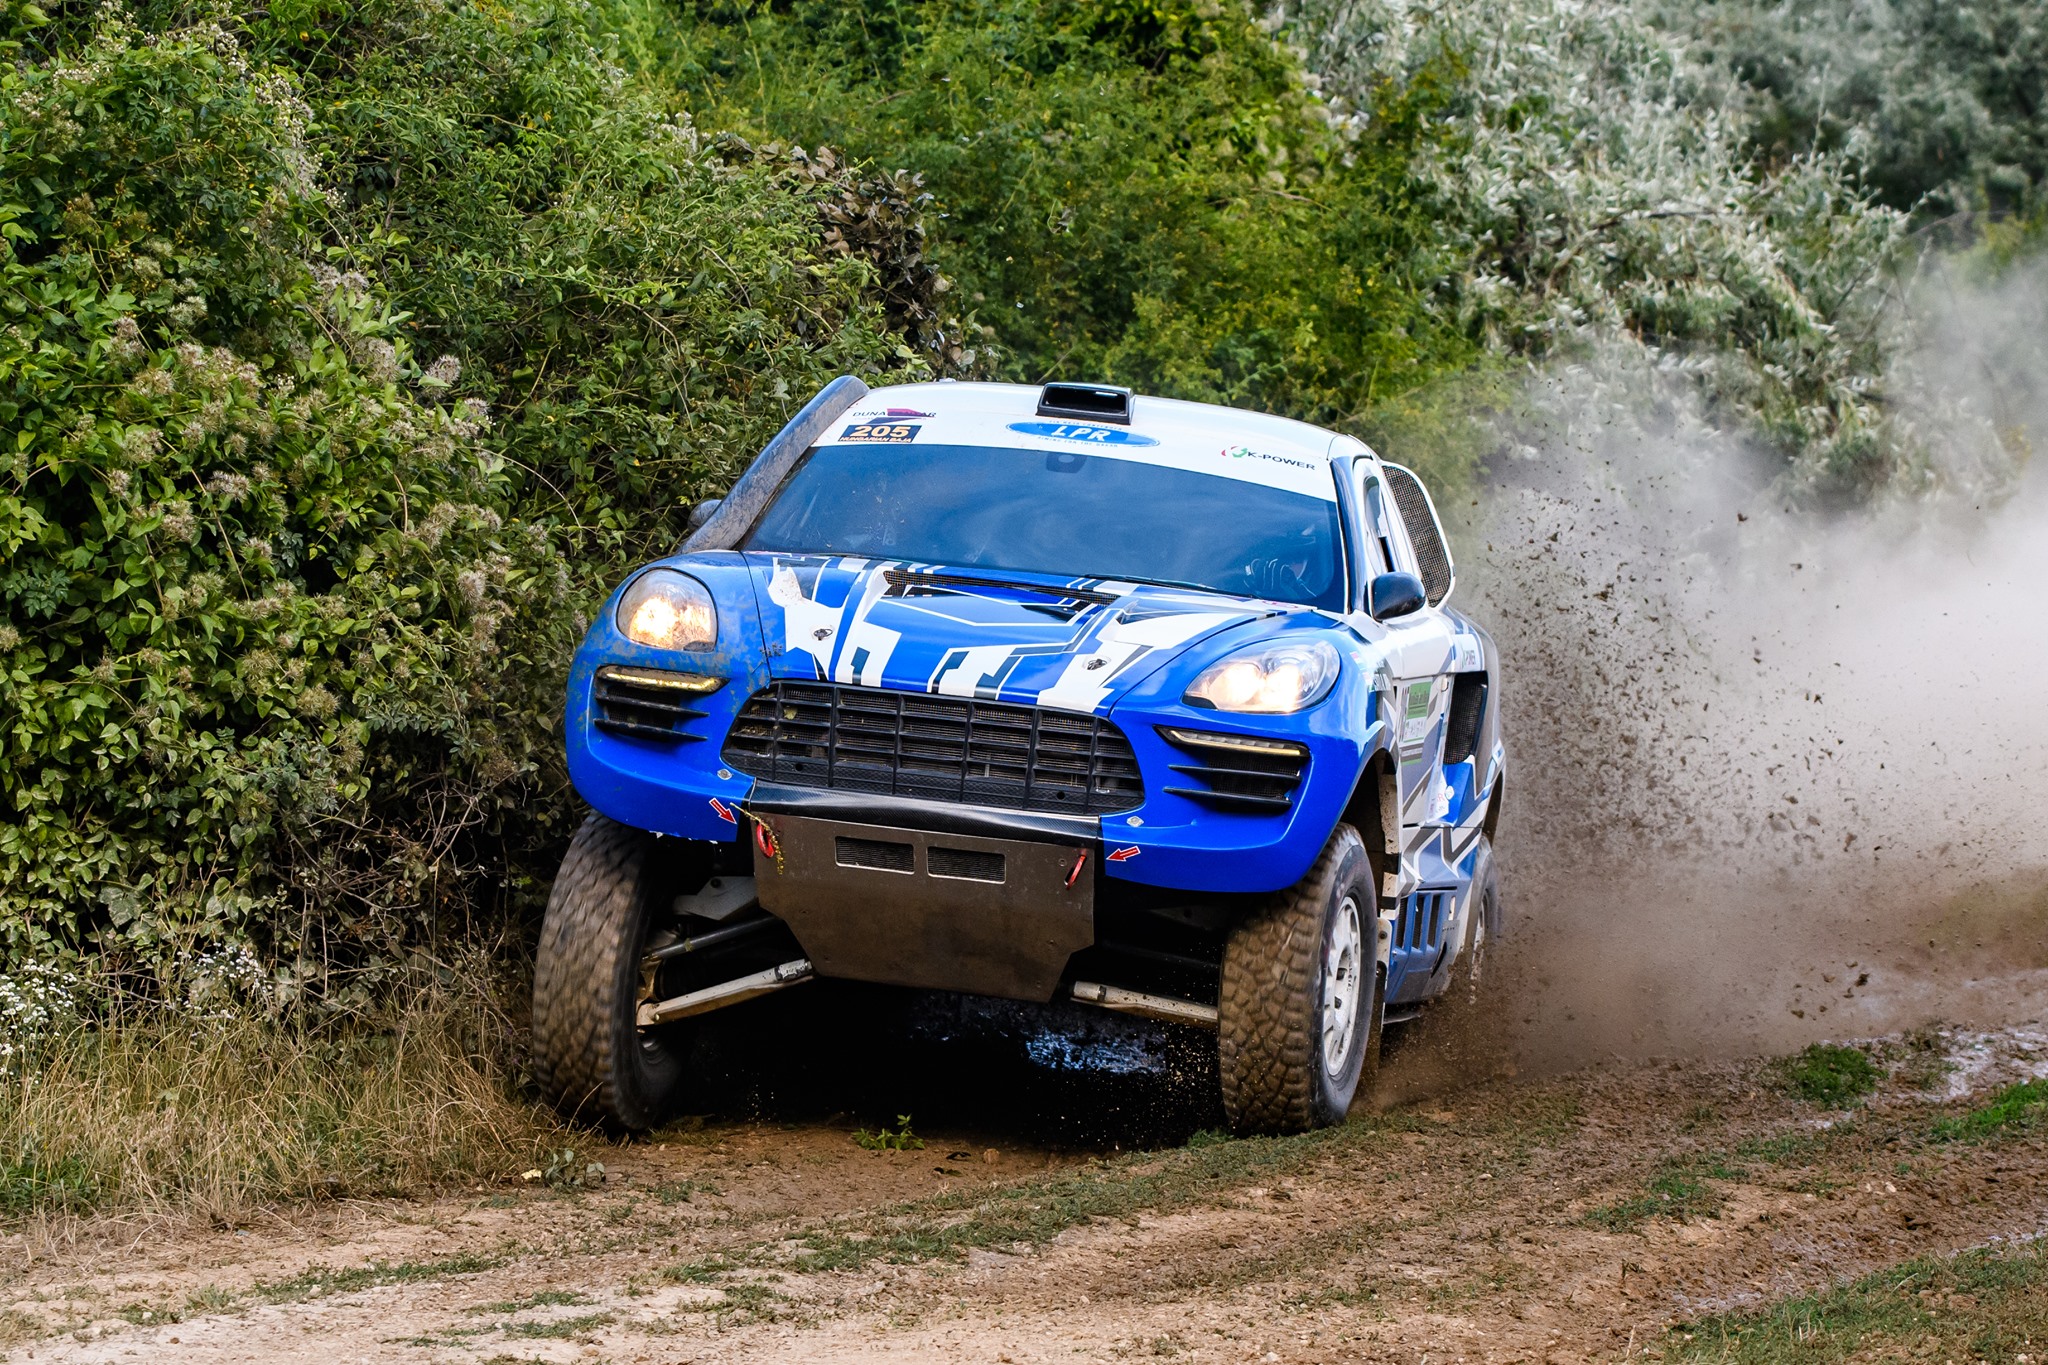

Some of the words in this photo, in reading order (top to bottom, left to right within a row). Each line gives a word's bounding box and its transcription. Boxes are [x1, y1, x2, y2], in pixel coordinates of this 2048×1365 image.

[850, 425, 912, 438] 205
[1051, 425, 1111, 442] LPR
[1247, 451, 1316, 470] K-POWER
